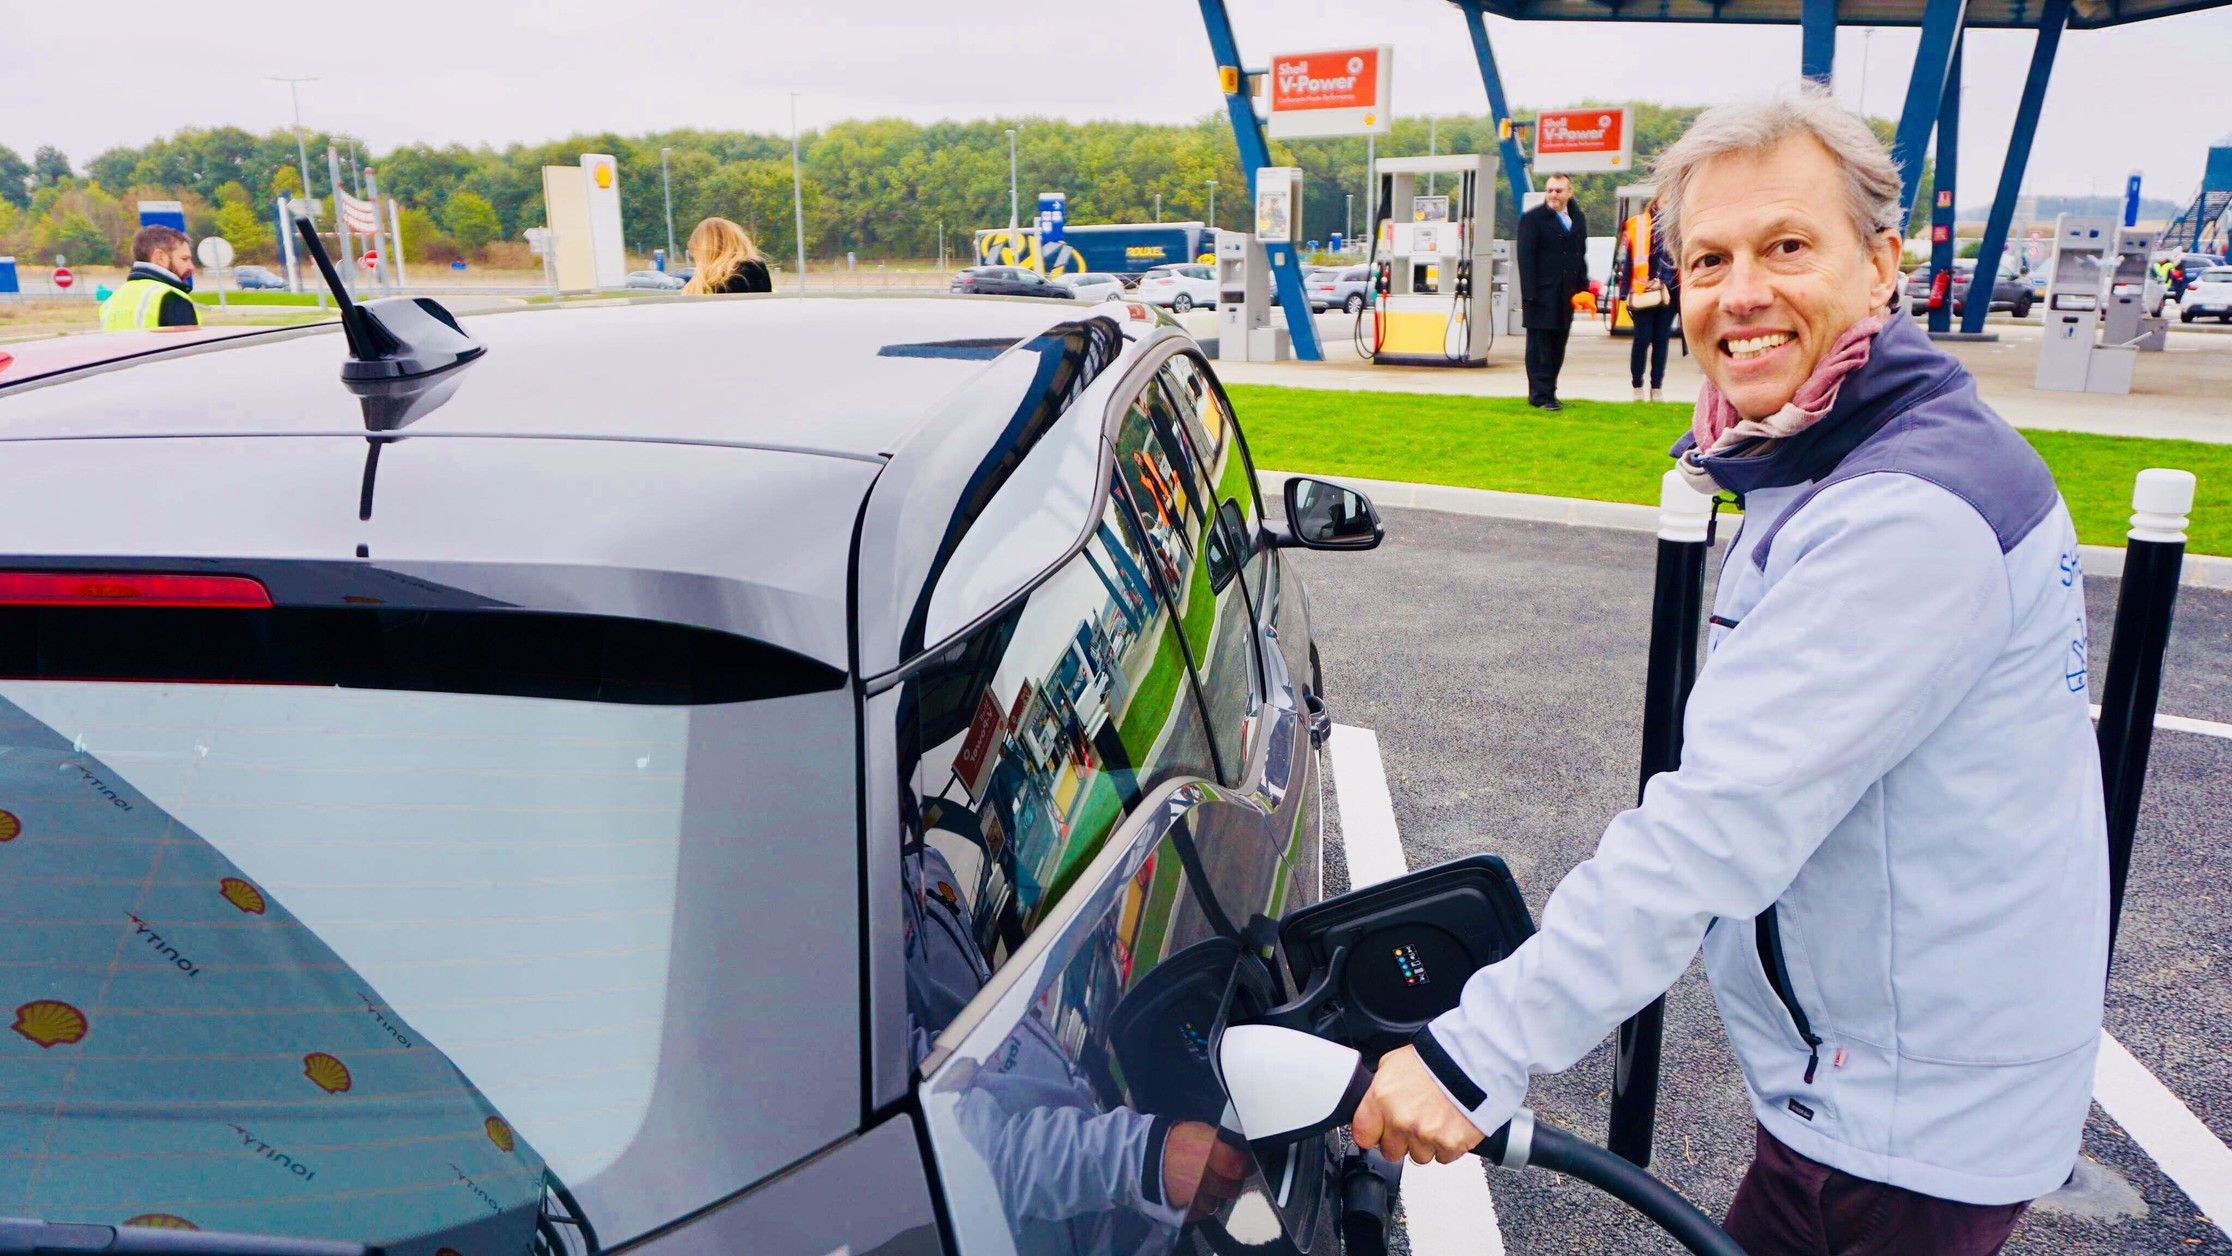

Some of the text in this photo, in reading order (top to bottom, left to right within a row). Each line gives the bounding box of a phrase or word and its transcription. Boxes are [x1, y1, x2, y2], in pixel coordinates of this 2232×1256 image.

[1279, 61, 1308, 76] Shell
[1279, 75, 1356, 94] V-Power
[1543, 117, 1568, 128] Shell
[1543, 127, 1605, 140] V-Power
